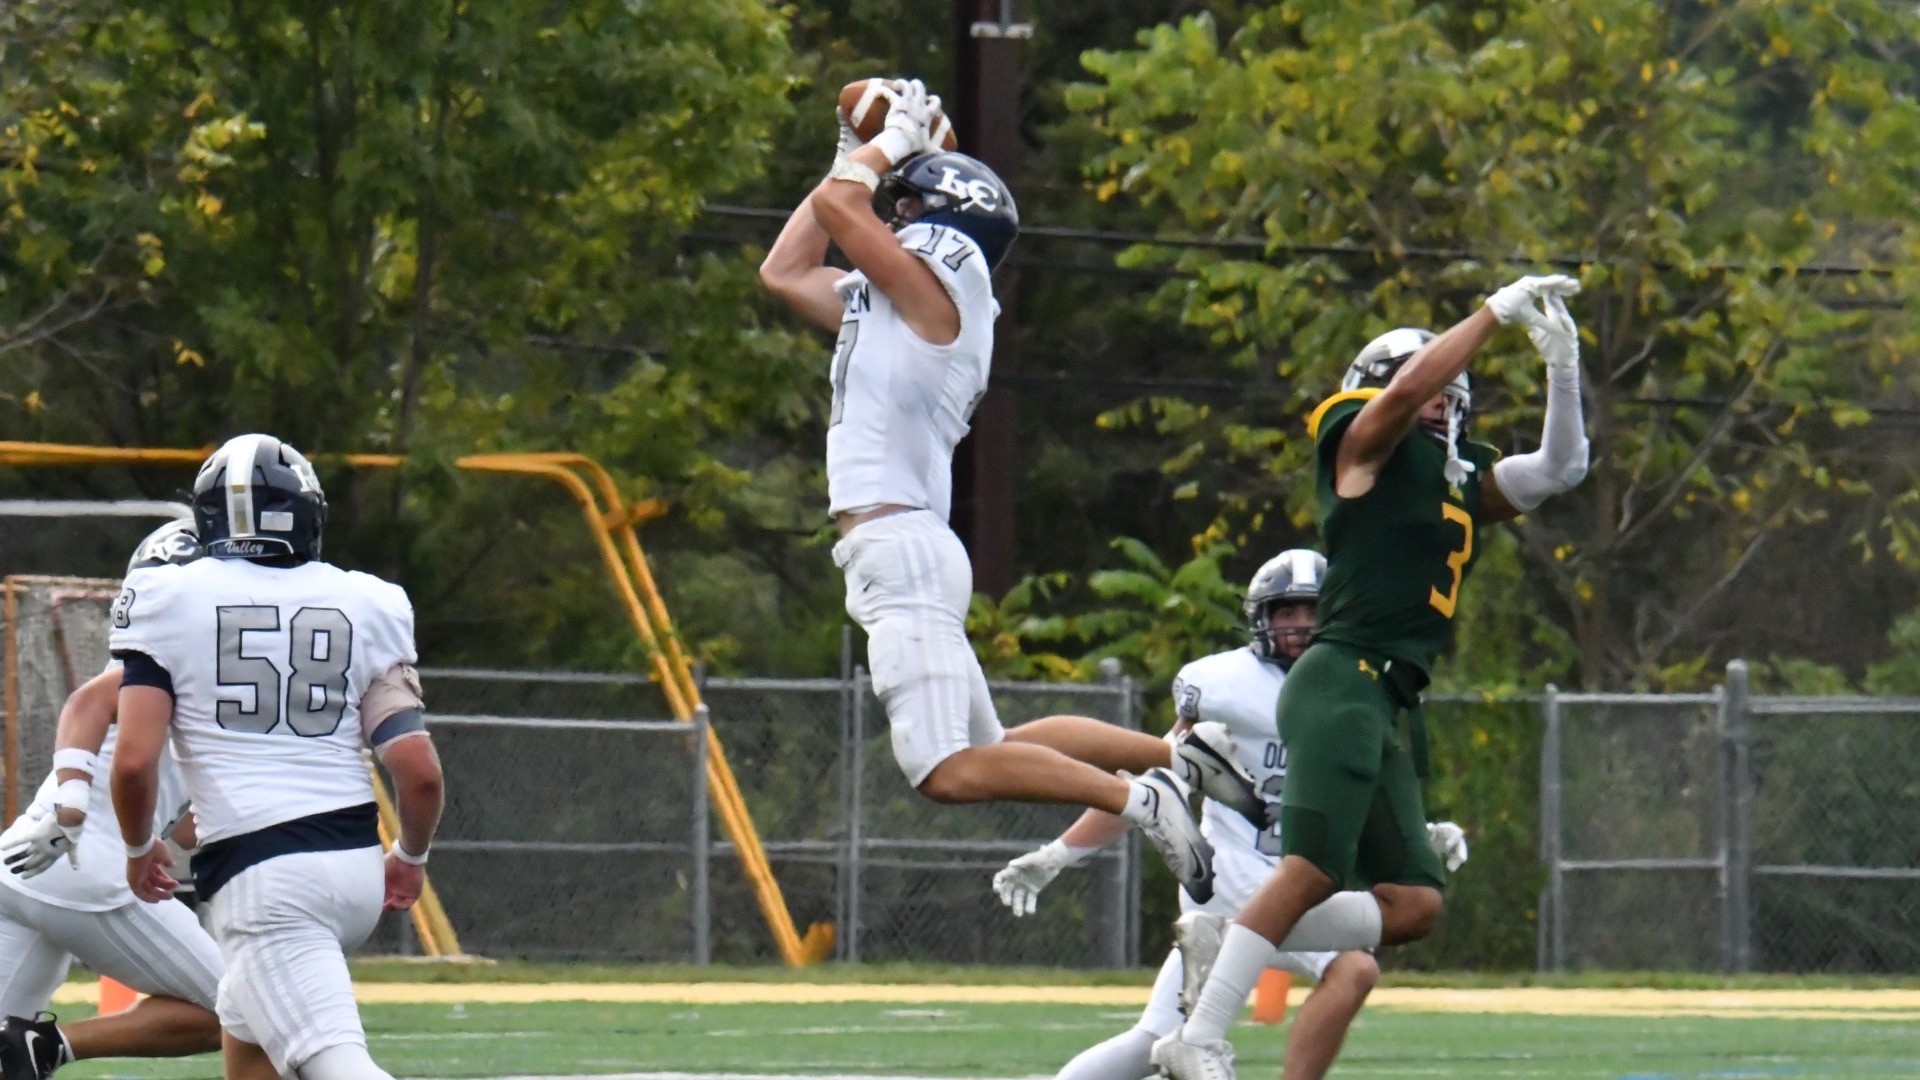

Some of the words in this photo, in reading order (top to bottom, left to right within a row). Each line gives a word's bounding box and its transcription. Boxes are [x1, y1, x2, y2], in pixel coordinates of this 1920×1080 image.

[917, 223, 976, 273] 17
[224, 540, 265, 555] Valley
[1428, 501, 1474, 620] 3
[215, 604, 353, 738] 58
